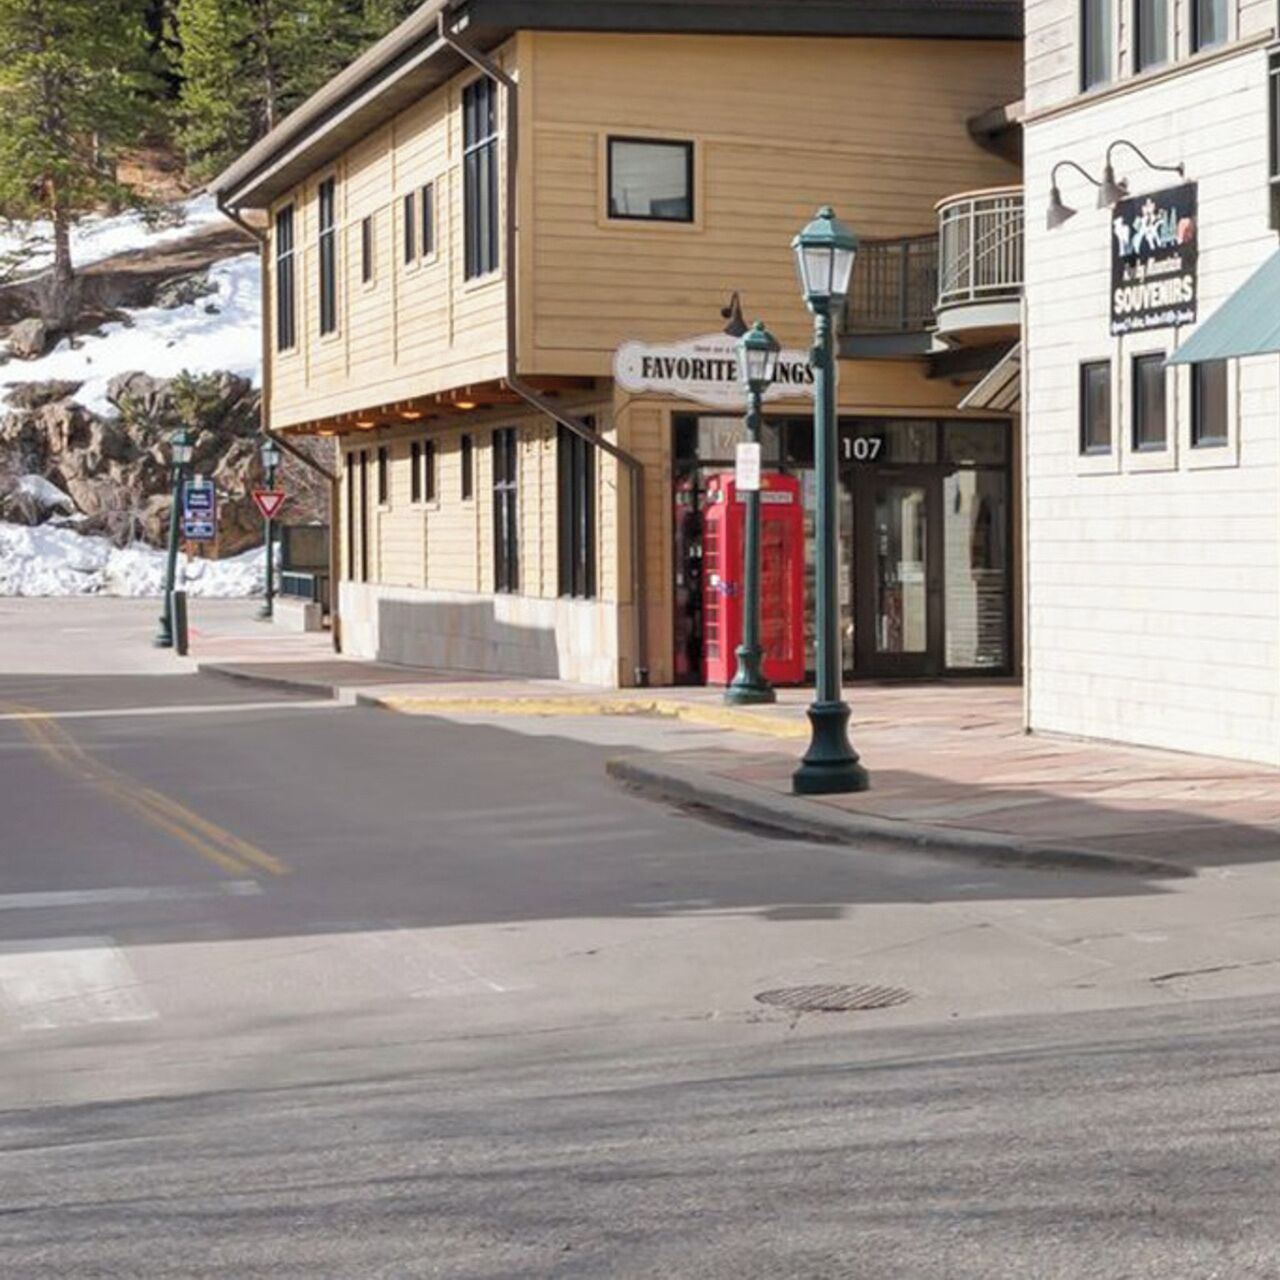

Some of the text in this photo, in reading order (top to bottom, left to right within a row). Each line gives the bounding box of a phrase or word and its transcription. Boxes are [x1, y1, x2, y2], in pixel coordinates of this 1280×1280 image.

[1114, 274, 1193, 314] SOUVENIRS
[641, 356, 737, 382] FAVORITE
[843, 437, 881, 459] 107
